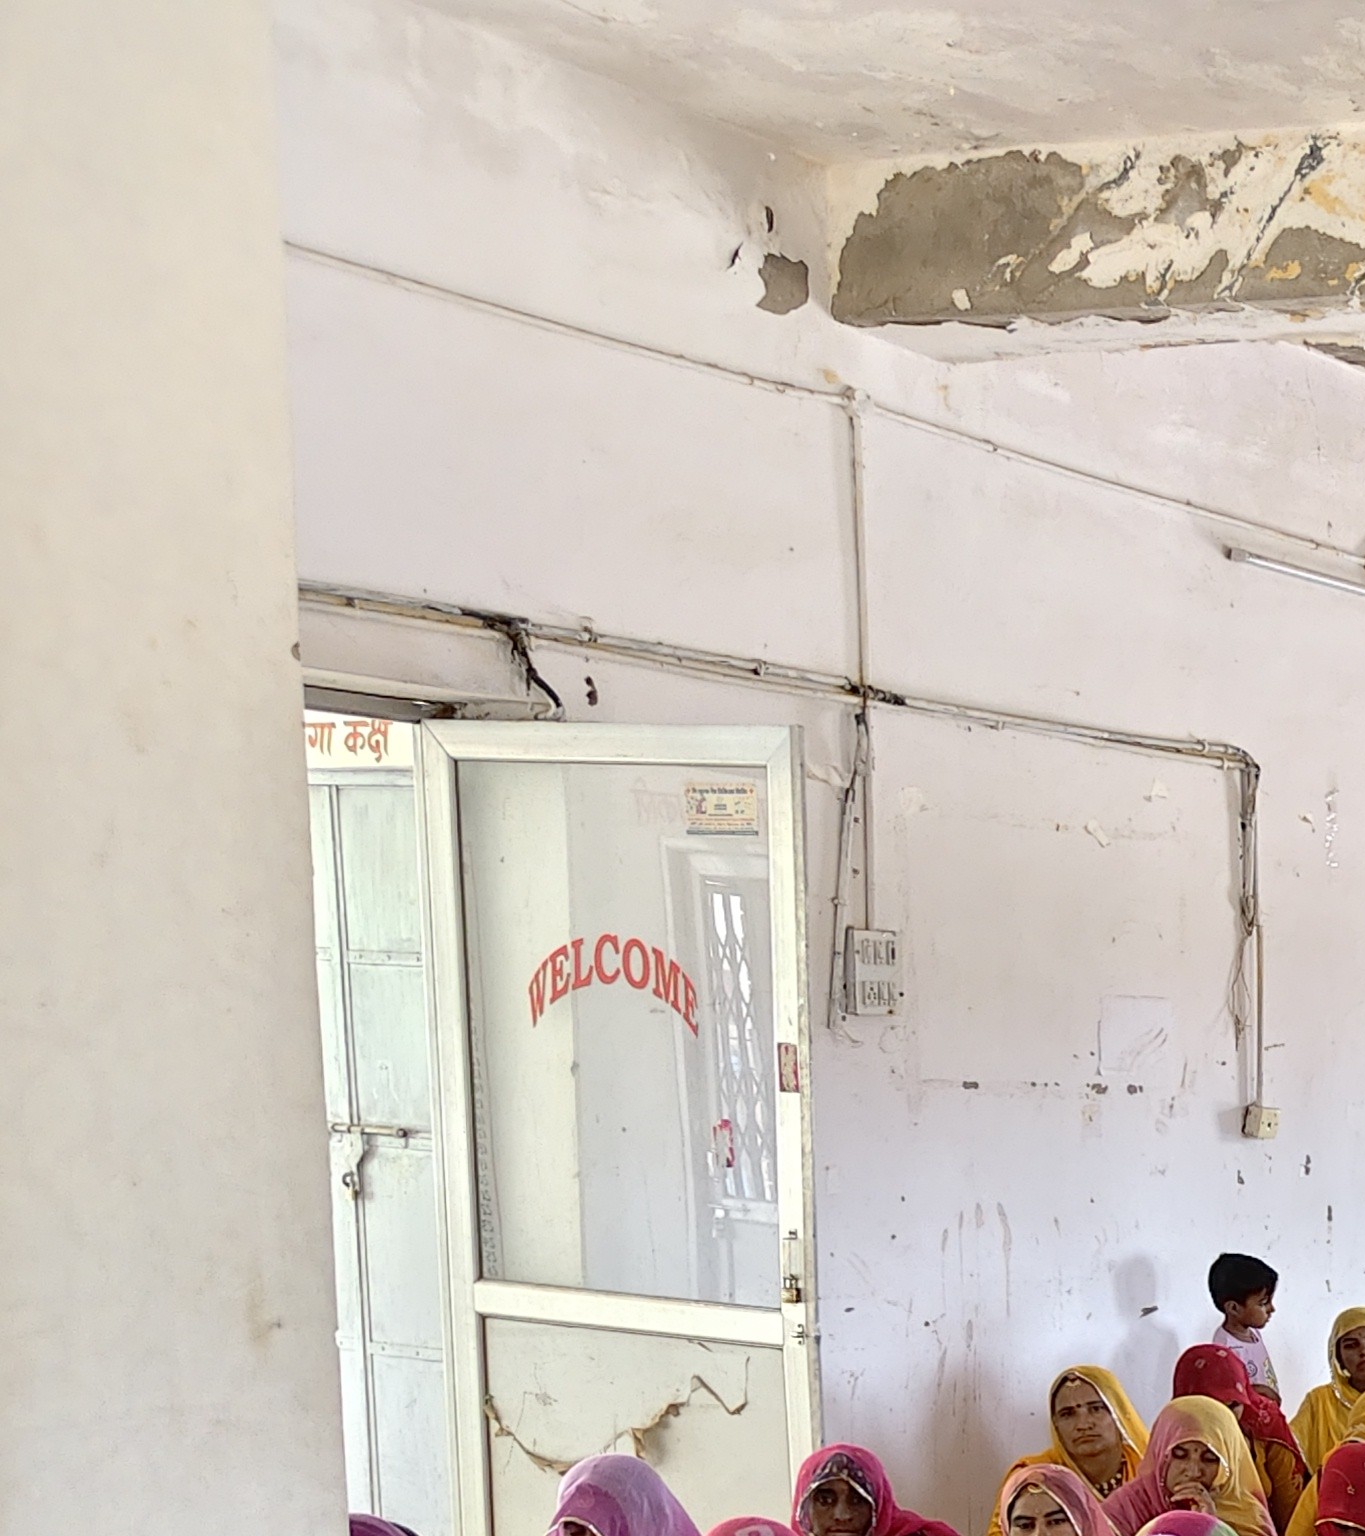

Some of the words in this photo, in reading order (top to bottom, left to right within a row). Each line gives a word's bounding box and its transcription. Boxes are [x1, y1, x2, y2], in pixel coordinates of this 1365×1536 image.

[303, 721, 336, 757] गा
[342, 719, 394, 764] कक्ष
[528, 934, 699, 1039] WELCOME
